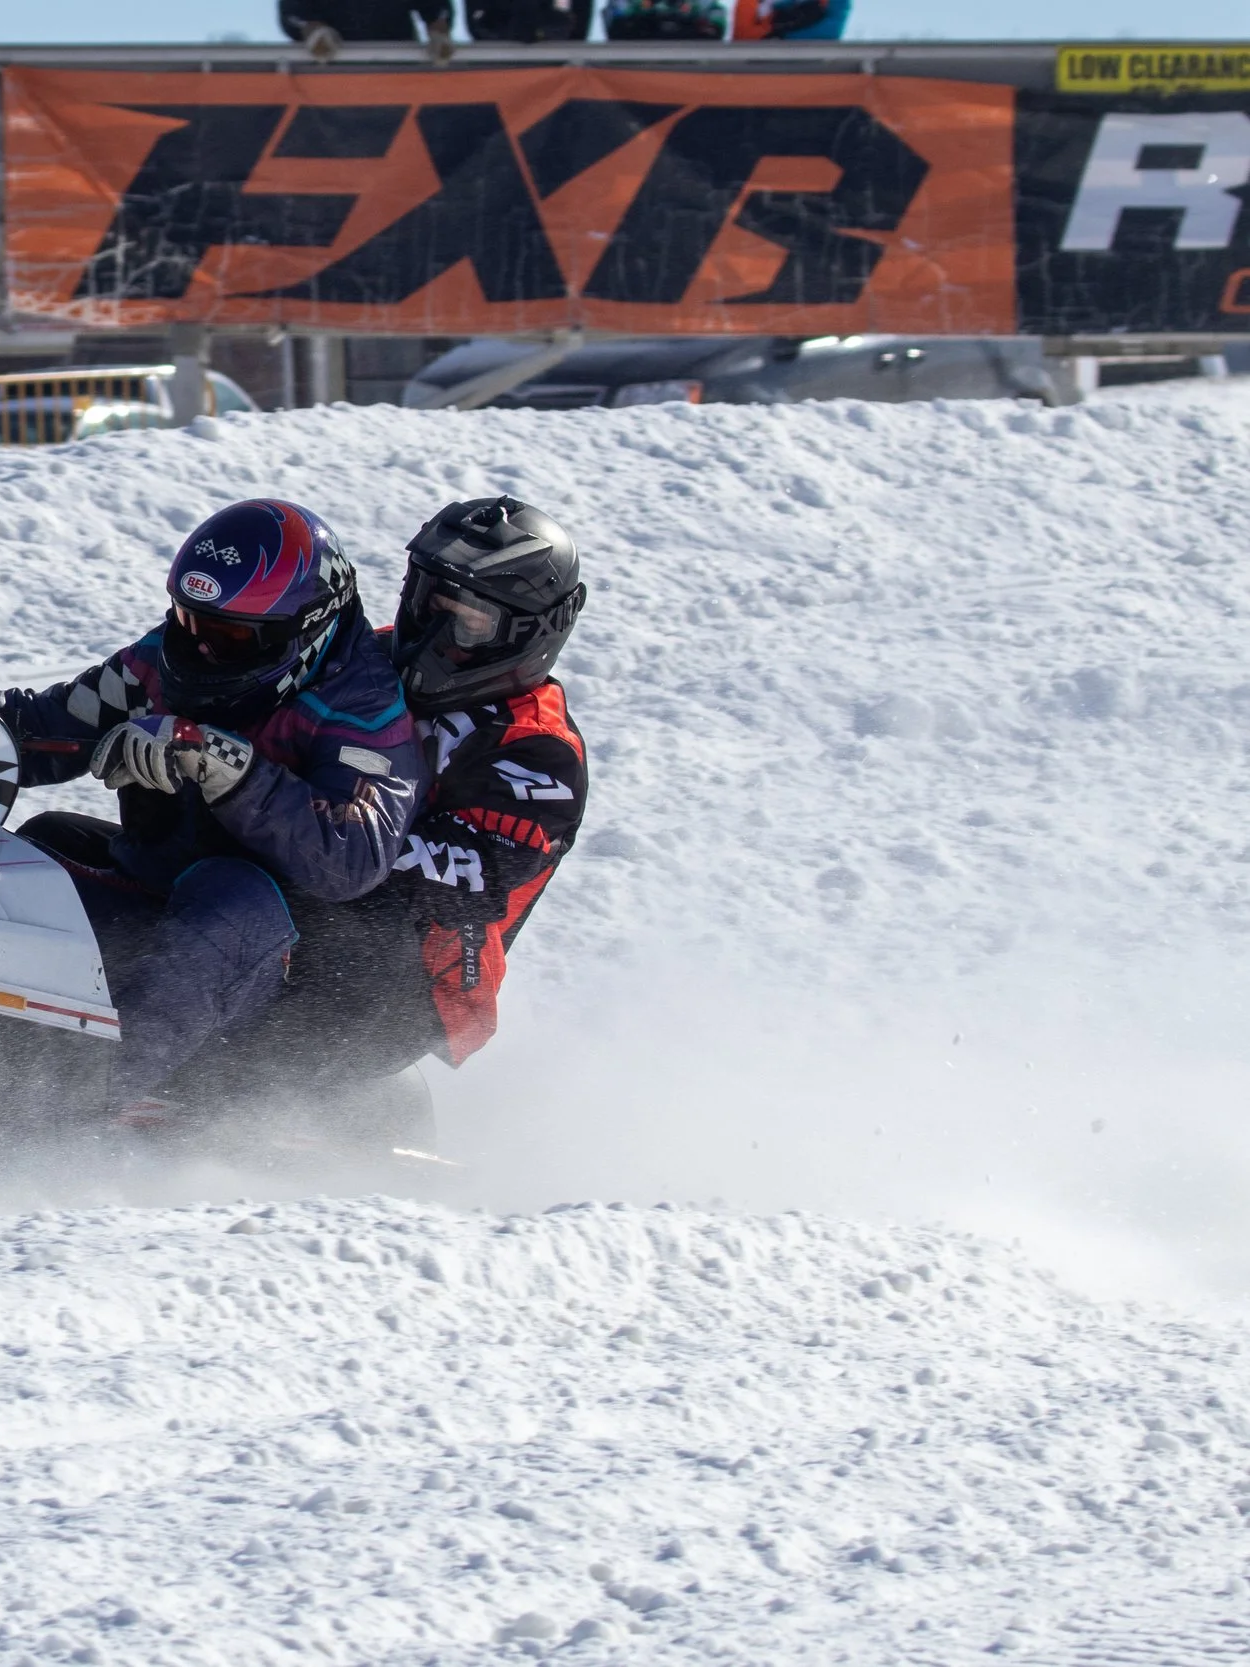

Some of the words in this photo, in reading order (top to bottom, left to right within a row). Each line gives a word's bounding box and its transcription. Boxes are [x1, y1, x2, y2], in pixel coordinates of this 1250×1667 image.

[1067, 54, 1120, 80] LOW
[76, 98, 930, 304] FXR
[187, 575, 213, 594] BELL
[392, 834, 485, 892] XR
[465, 946, 476, 984] RIDE
